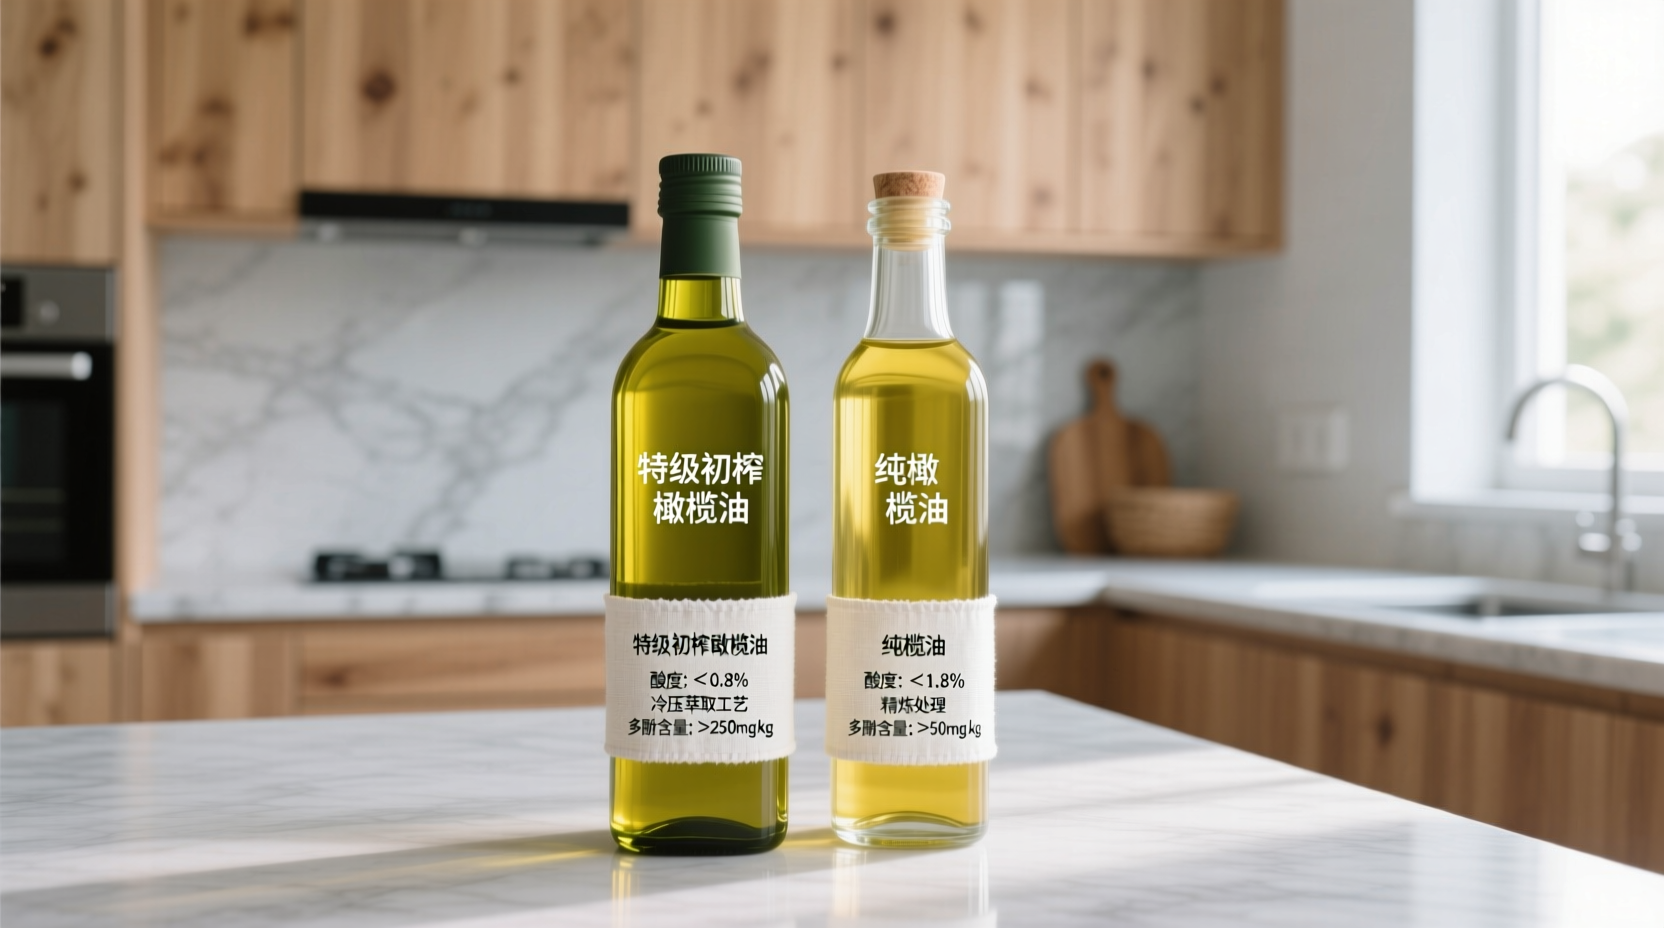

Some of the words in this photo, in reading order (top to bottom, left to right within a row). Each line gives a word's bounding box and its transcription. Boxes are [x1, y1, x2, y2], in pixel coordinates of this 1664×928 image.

[637, 451, 764, 486] 特级初榨
[874, 452, 940, 486] 纯橄
[652, 491, 749, 525] 橄榄油
[885, 491, 949, 525] 榄油
[881, 633, 946, 657] 纯榄油
[651, 694, 749, 714] 冷压萃取工艺
[880, 696, 946, 715] 精炼处理
